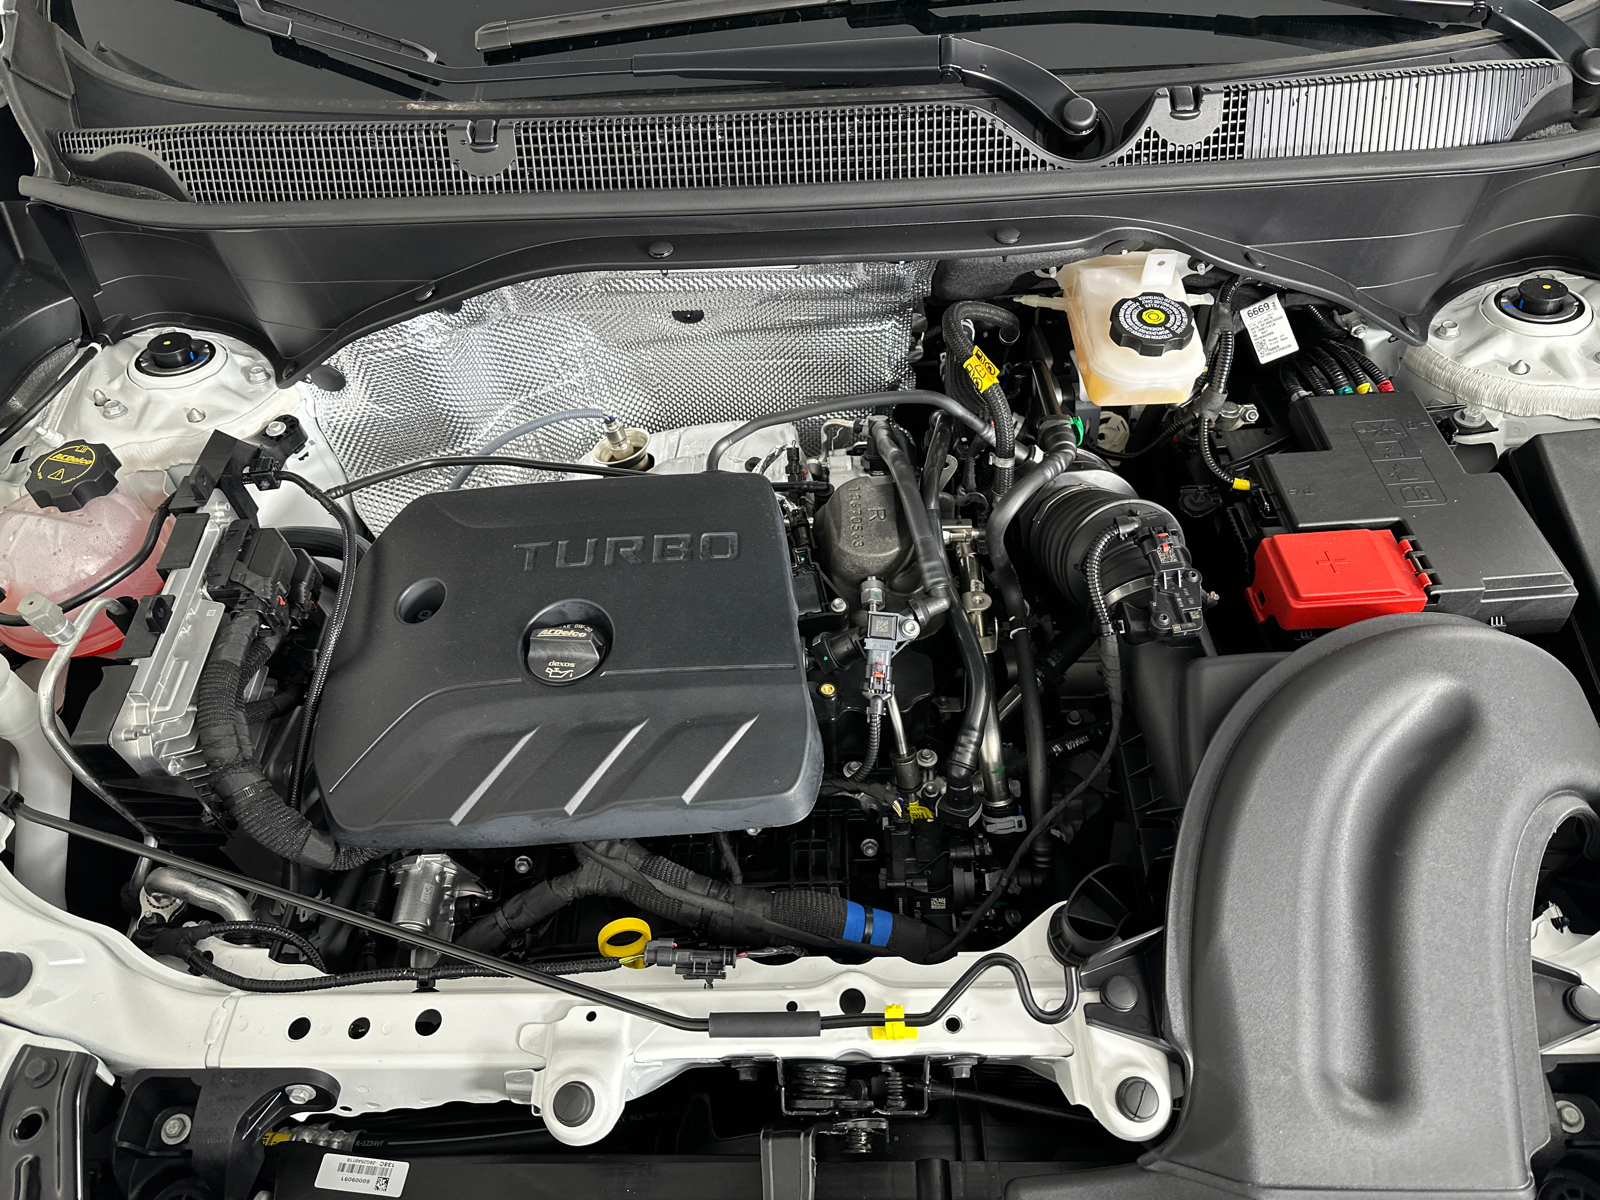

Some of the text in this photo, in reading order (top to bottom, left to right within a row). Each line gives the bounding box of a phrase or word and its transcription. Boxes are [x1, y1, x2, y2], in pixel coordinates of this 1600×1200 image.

[1247, 302, 1270, 318] 6669
[52, 453, 93, 465] ACDelco
[868, 508, 887, 522] R
[513, 531, 740, 572] TURBO
[536, 629, 587, 637] ACDelco
[548, 660, 576, 668] dexos
